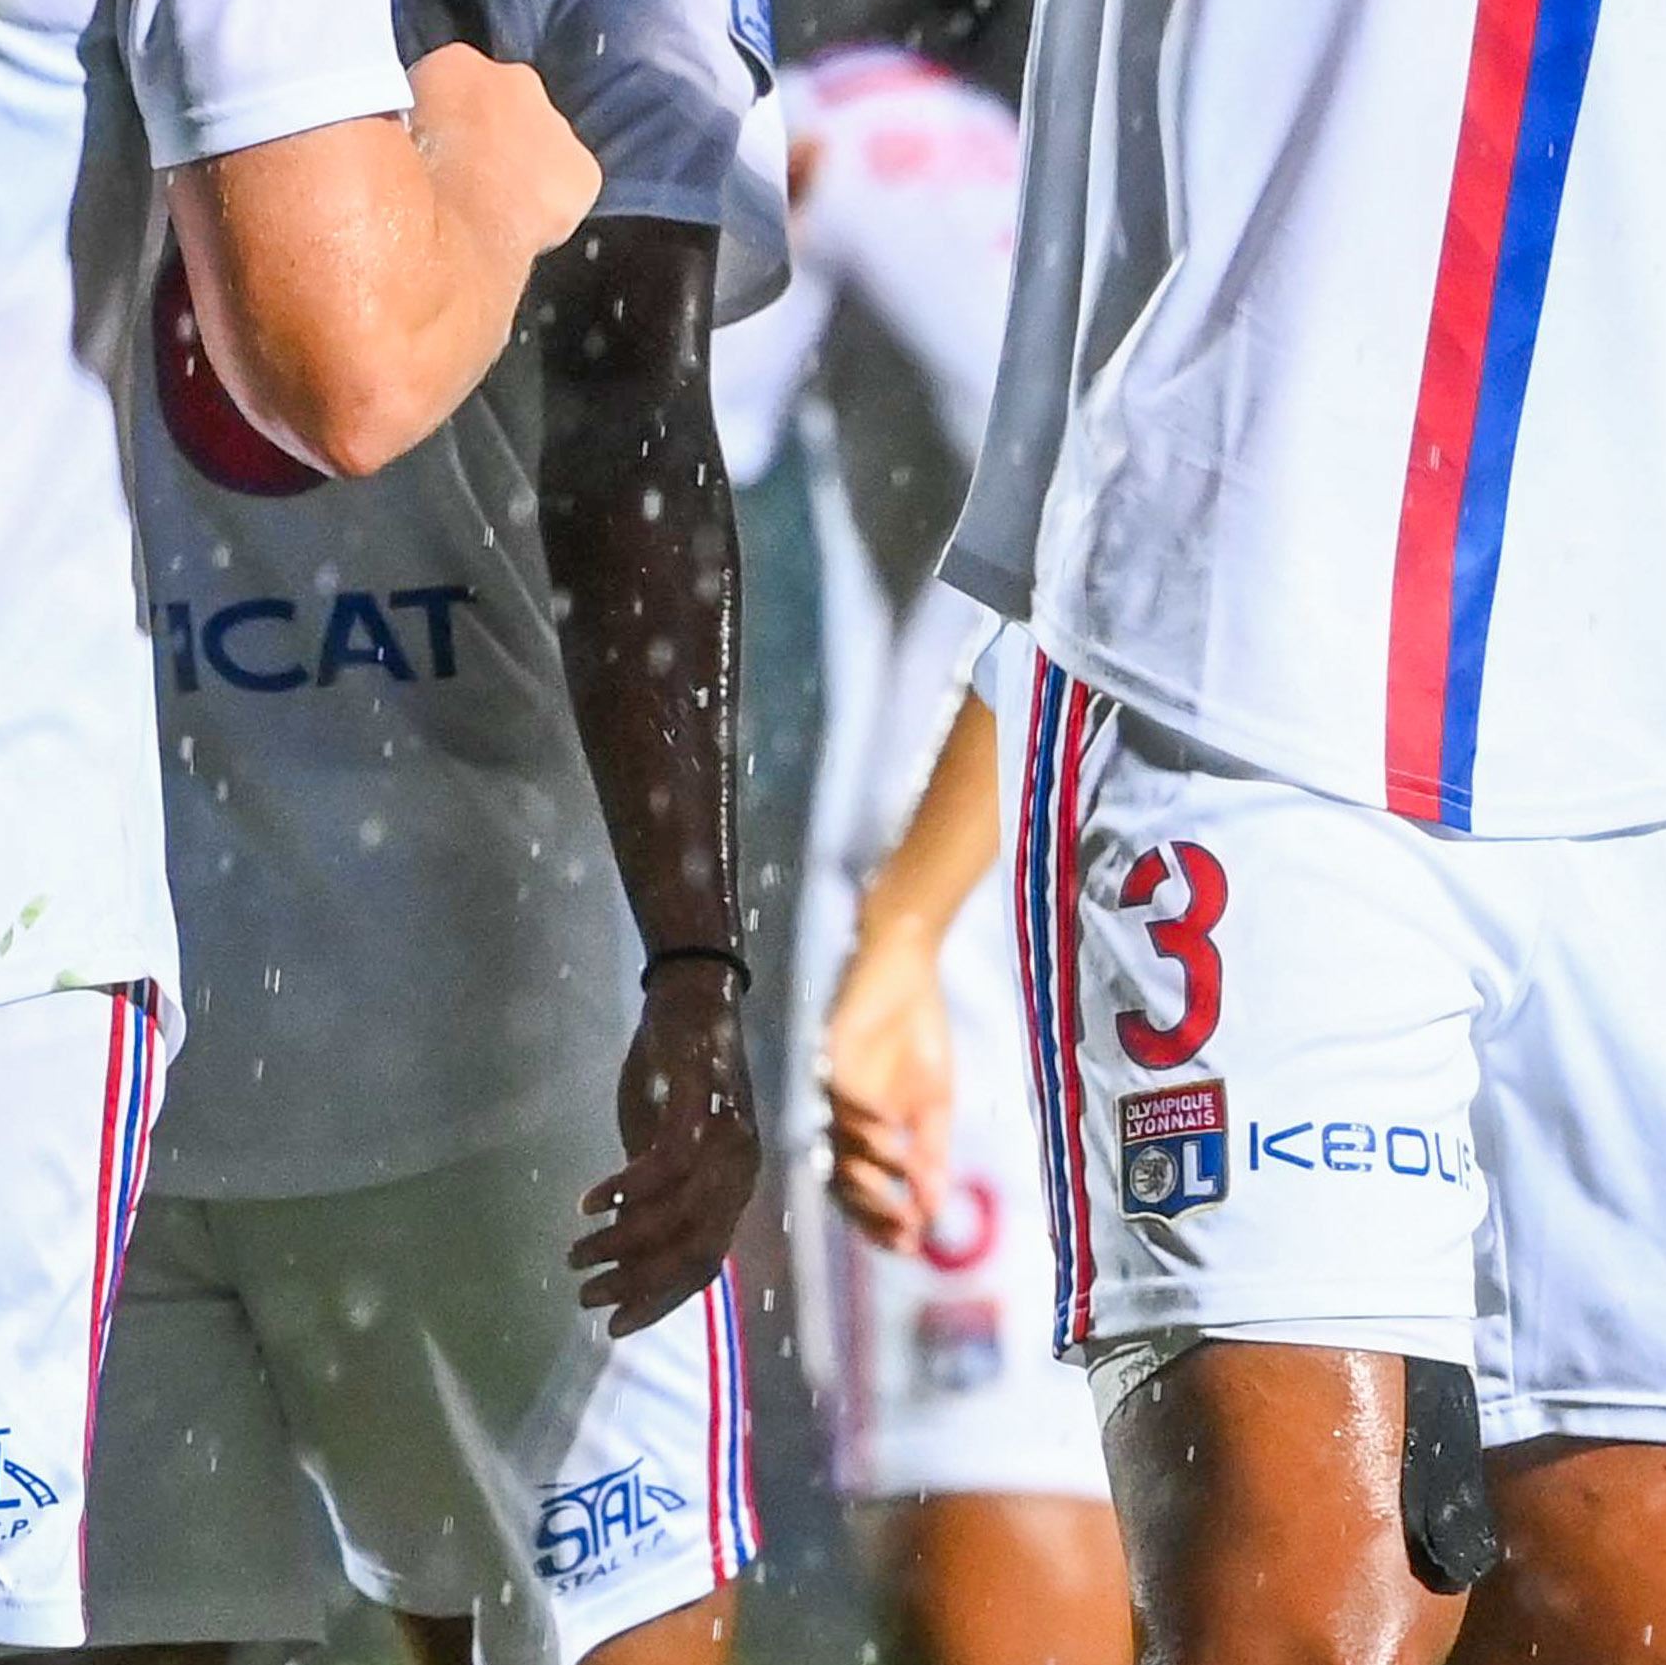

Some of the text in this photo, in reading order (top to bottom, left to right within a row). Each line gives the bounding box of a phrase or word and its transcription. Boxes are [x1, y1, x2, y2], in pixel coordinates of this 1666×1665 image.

[149, 585, 477, 693] ICAT
[1115, 839, 1228, 1071] 3
[1125, 1092, 1215, 1121] OLYMPIQUE
[1126, 1109, 1217, 1138] LYONNAIS
[556, 1557, 622, 1596] STAL
